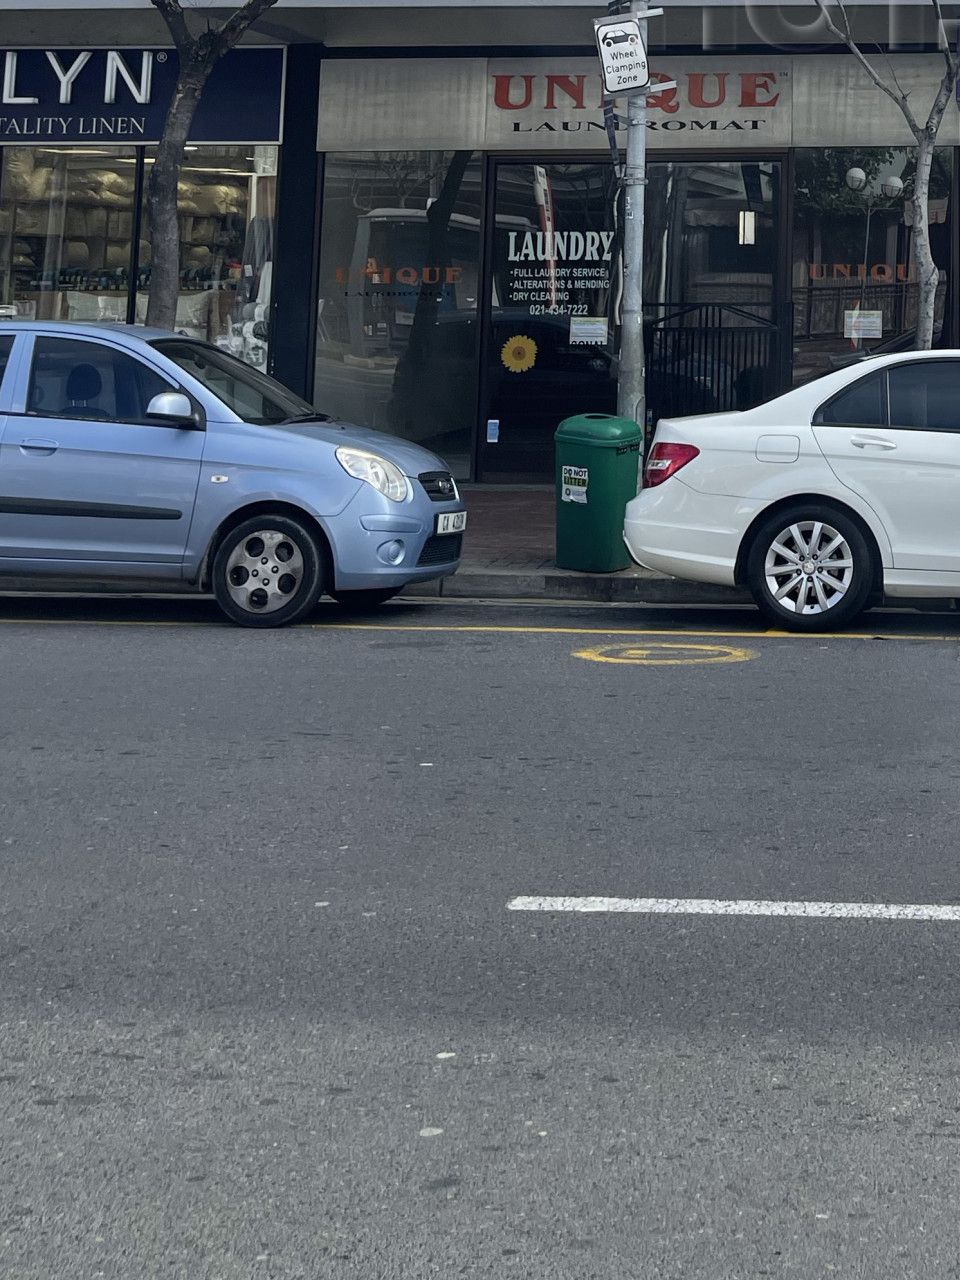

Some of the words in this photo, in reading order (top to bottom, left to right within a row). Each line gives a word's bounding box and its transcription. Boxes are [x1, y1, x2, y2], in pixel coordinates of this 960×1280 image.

[610, 49, 638, 61] Wheel
[606, 61, 646, 75] Clamping
[2, 51, 153, 104] LYN
[617, 75, 638, 85] Zone
[492, 72, 780, 113] UNQUE
[79, 117, 145, 135] LINEN
[508, 231, 614, 262] LAUNDRY
[514, 268, 533, 278] FULL
[572, 268, 605, 277] SERVICE
[513, 280, 566, 289] ALTERATIONS
[567, 280, 573, 289] &
[574, 280, 610, 289] MENDING
[513, 292, 529, 301] DRY
[574, 469, 588, 478] NOT
